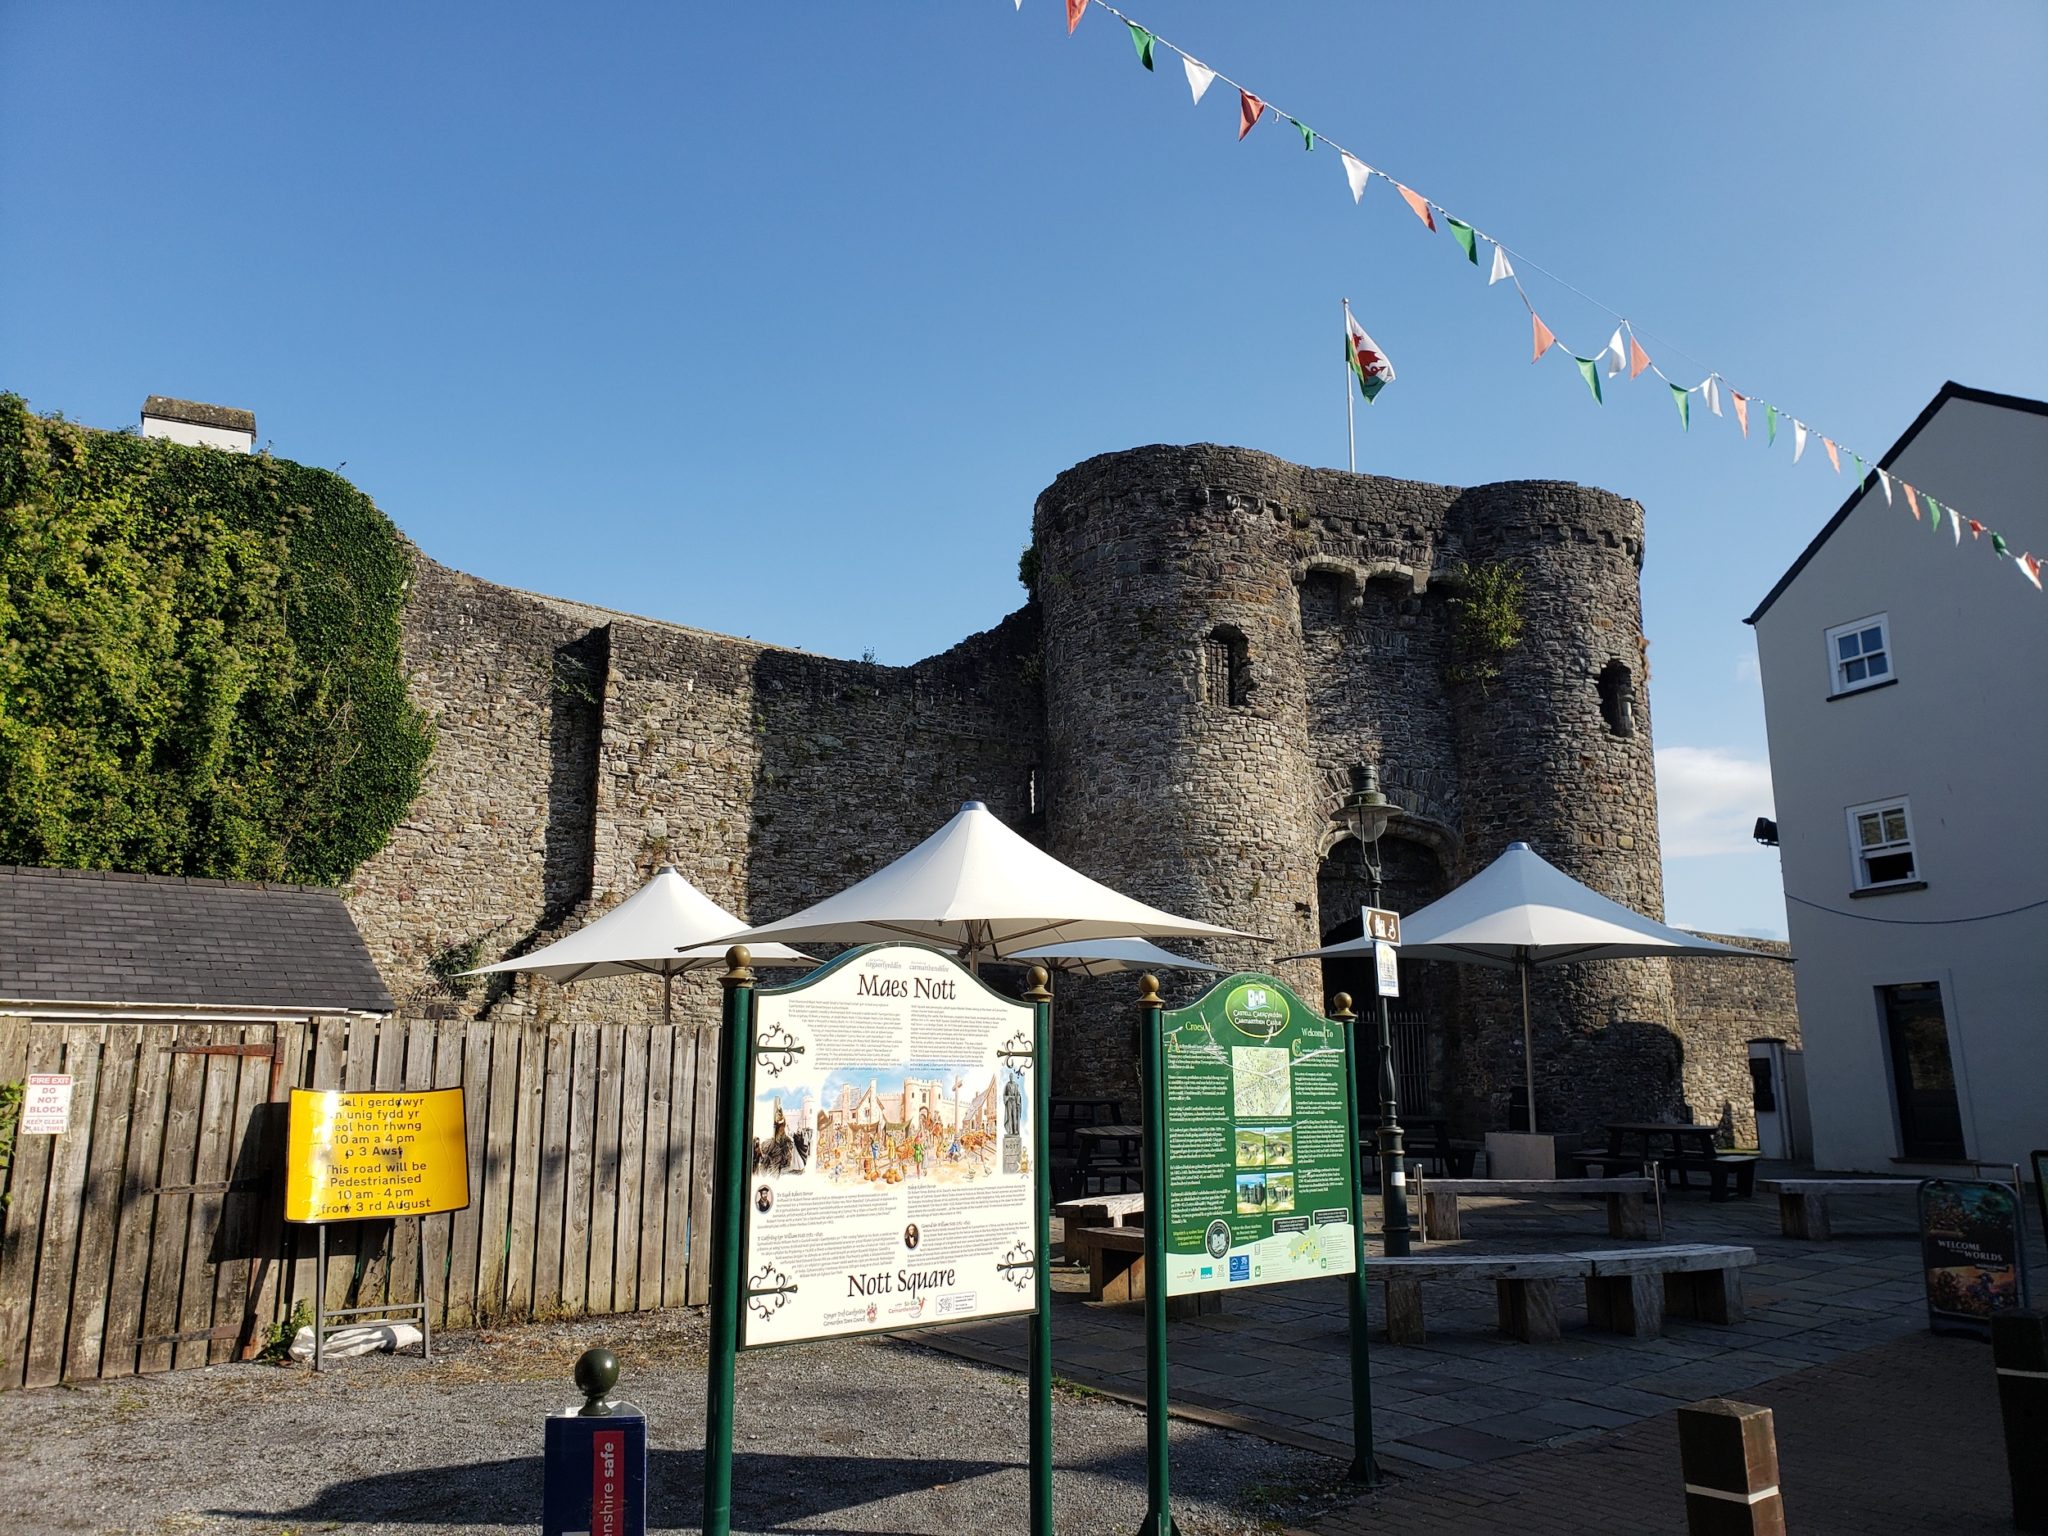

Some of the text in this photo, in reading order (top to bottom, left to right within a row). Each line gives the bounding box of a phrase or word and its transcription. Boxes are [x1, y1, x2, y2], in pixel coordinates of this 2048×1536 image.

[857, 974, 956, 1000] Maes Nott
[347, 1110, 373, 1121] unig
[377, 1109, 404, 1120] fydd
[408, 1110, 420, 1119] yr
[357, 1122, 378, 1132] hon
[384, 1122, 422, 1132] rhwng
[335, 1134, 349, 1144] 10
[351, 1136, 370, 1144] am
[385, 1134, 393, 1143] 4
[396, 1135, 415, 1145] pm
[359, 1147, 367, 1156] 3
[372, 1146, 403, 1156] Awst
[326, 1162, 427, 1174] This road will be
[330, 1174, 422, 1188] Pedestrianised
[338, 1190, 352, 1200] 10
[355, 1191, 374, 1199] am
[384, 1188, 392, 1197] 4
[395, 1189, 414, 1199] pm
[356, 1202, 364, 1212] 3
[387, 1198, 431, 1211] August
[1937, 1239, 1981, 1251] WELCOME
[1964, 1250, 2003, 1262] WORLDS
[847, 1268, 956, 1299] Nott Square
[600, 1442, 614, 1477] safe
